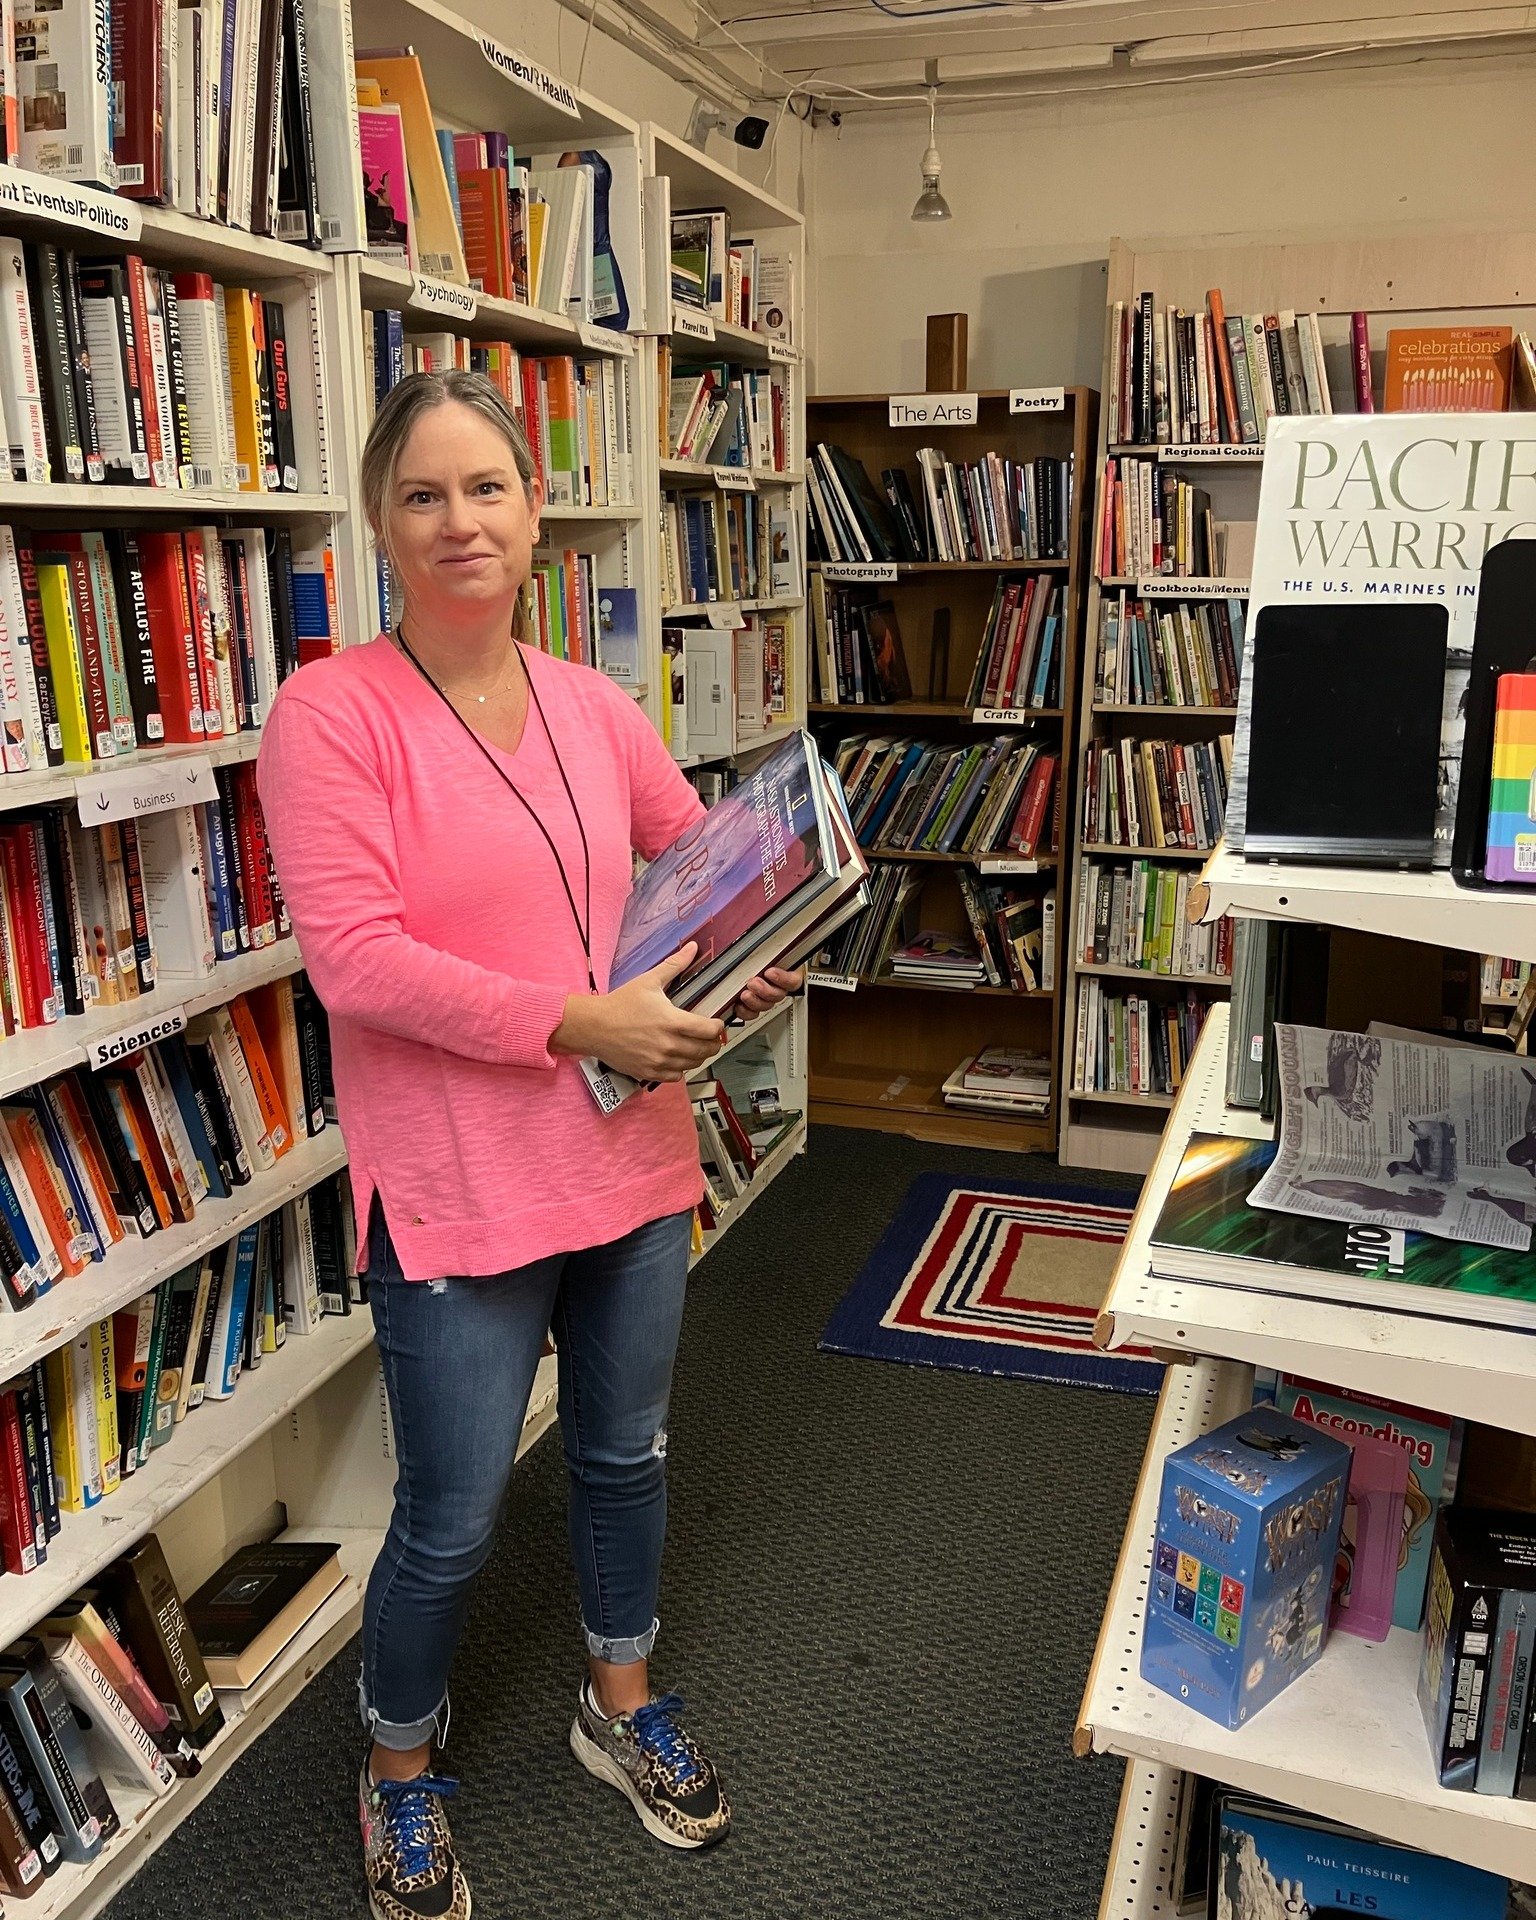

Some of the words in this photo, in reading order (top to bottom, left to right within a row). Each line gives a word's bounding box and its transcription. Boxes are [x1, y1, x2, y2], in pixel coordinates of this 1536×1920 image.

[541, 74, 576, 110] Health
[47, 252, 63, 314] BENAZIR
[55, 317, 70, 376] BHUTTO
[121, 294, 130, 312] HOW
[135, 278, 148, 331] CONSERVATIVE
[165, 283, 180, 344] MICHAEL
[419, 281, 475, 311] Psychology
[15, 288, 25, 306] THE
[22, 343, 37, 394] REVOLUTION
[151, 322, 162, 356] RAGE
[682, 319, 699, 333] Travel
[1243, 318, 1252, 344] PALEO
[141, 333, 151, 357] HEART
[272, 339, 286, 369] Our
[1246, 345, 1255, 366] HAPPY
[1255, 337, 1268, 378] chocolate
[1399, 339, 1502, 356] celebrations
[172, 350, 185, 395] COHEN
[274, 369, 289, 410] Guys
[1235, 359, 1250, 411] Entertaining
[1249, 367, 1258, 387] HOUR
[1269, 331, 1282, 381] PRACTICAL
[1276, 384, 1286, 412] PALEO
[892, 405, 927, 422] The
[933, 404, 972, 421] Arts
[1015, 397, 1060, 408] Poetry
[176, 402, 192, 463] REVENGE
[1165, 447, 1221, 458] Regional
[717, 471, 731, 483] Travel
[3, 534, 19, 588] MICHAEL
[13, 592, 25, 628] LEWIS
[74, 560, 90, 612] STORM
[193, 552, 207, 593] THIS
[826, 567, 894, 579] Photography
[1283, 581, 1313, 592] THE
[1323, 582, 1354, 593] U.S.
[1364, 583, 1446, 596] MARINES
[1456, 585, 1477, 597] IN
[129, 570, 150, 641] APOLLO'S
[183, 633, 195, 668] DAVID
[199, 608, 215, 661] TOWN
[22, 653, 31, 671] THE
[84, 636, 100, 679] LAND
[139, 648, 156, 685] FIRE
[0, 649, 18, 703] FURY
[25, 674, 37, 714] FIFTH
[221, 666, 232, 710] WILSON
[91, 688, 105, 724] RAIN
[983, 709, 1019, 720] Crafts
[133, 792, 176, 810] Business
[765, 778, 777, 801] NASA
[212, 814, 221, 830] An
[752, 773, 770, 845] PHOTOGRAPH
[24, 830, 39, 876] PATRICK
[213, 831, 225, 856] Ugly
[769, 800, 788, 871] ASTRONAUTS
[217, 857, 229, 887] Truth
[762, 843, 773, 866] THE
[763, 866, 776, 901] EARTH
[31, 878, 47, 932] LENCIONI
[1095, 880, 1104, 925] COOKBOOK
[807, 973, 854, 986] ollections
[98, 1015, 182, 1064] Sciences
[1285, 1025, 1300, 1099] SOUND
[193, 1090, 218, 1146] BREAKTHROUGH
[0, 1168, 20, 1218] DEVICES
[303, 1217, 316, 1287] HUMMINGBIRDS
[100, 1320, 109, 1343] Girl
[201, 1308, 214, 1338] COAST
[34, 1368, 45, 1402] HISTORY
[101, 1346, 113, 1400] Decoded
[9, 1422, 21, 1467] MOUNTAINS
[83, 1382, 94, 1430] LIGHTNESS
[90, 1448, 99, 1477] BEING
[1292, 1394, 1435, 1468] According
[15, 1468, 25, 1498] BEYOND
[46, 1475, 56, 1506] HAWKING
[19, 1499, 32, 1543] MOUNTAINS
[167, 1597, 188, 1637] DESK
[157, 1607, 192, 1689] REFERENCE
[1514, 1655, 1527, 1683] ORSON
[1511, 1684, 1523, 1708] SCOTT
[1448, 1712, 1468, 1748] GAME
[1508, 1708, 1520, 1730] CARD
[1307, 1855, 1338, 1868] PAUL
[1344, 1863, 1410, 1883] TEISSEIRE
[1335, 1889, 1377, 1910] LES
